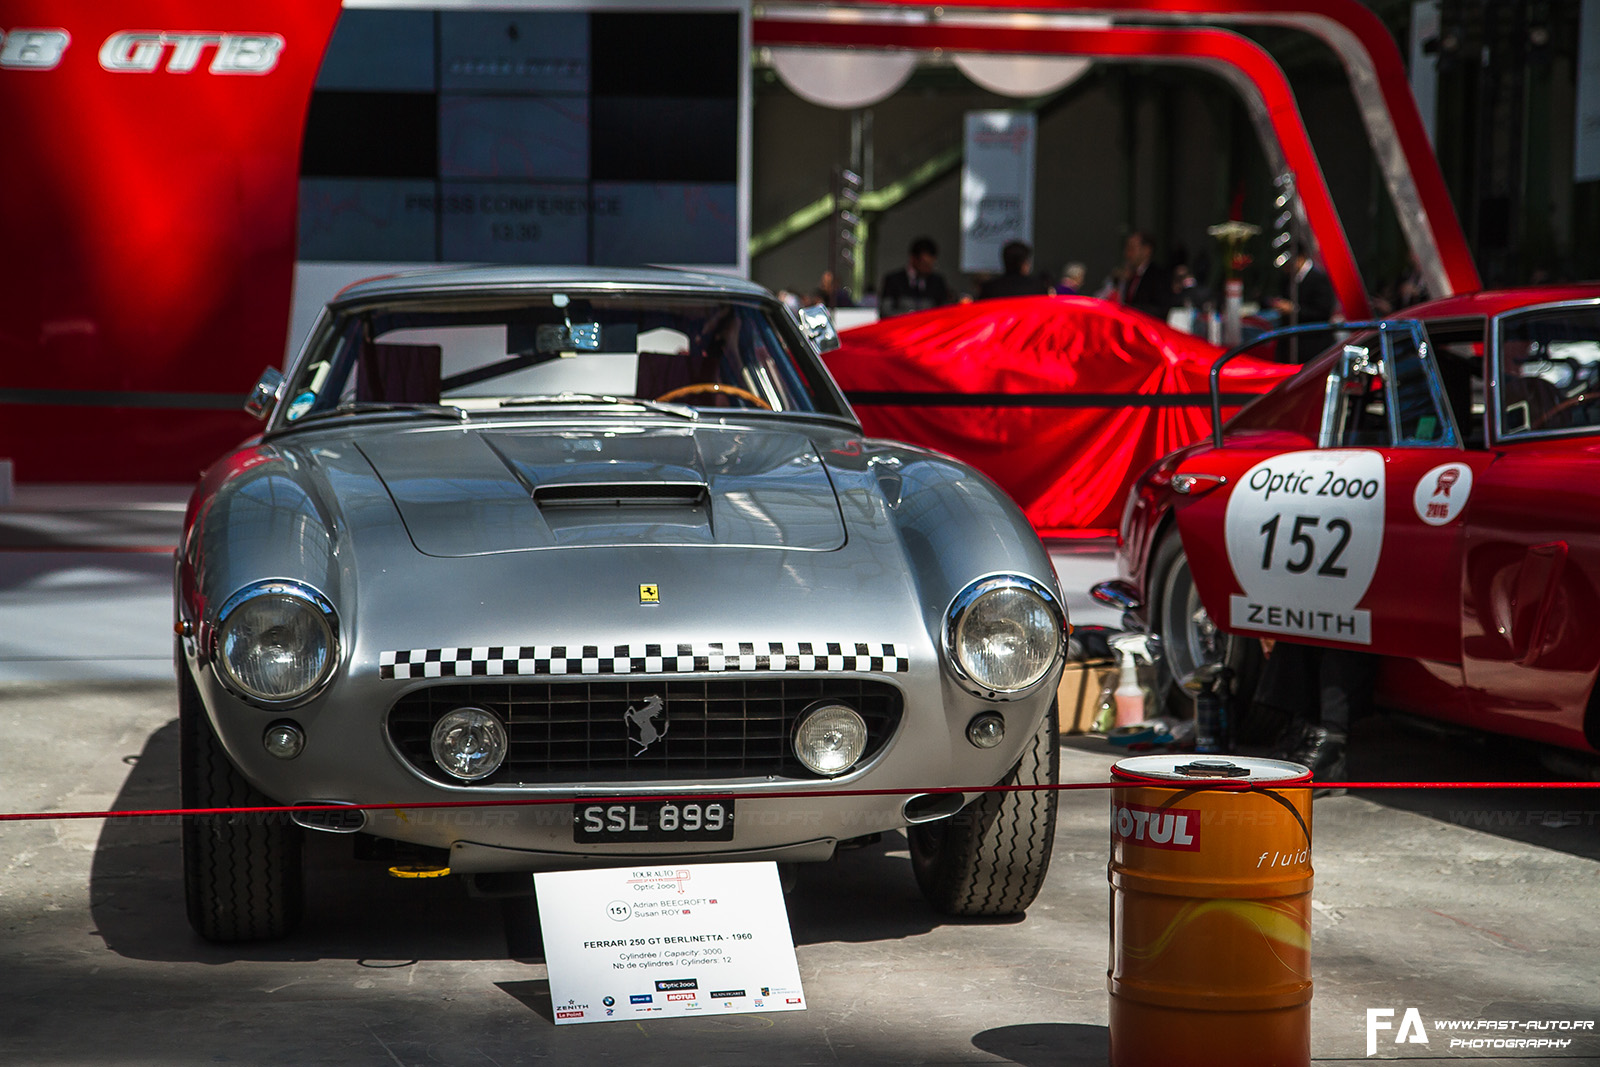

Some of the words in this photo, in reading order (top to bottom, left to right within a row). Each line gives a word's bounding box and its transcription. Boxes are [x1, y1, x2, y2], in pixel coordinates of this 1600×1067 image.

[98, 29, 285, 75] GTB
[1250, 467, 1314, 501] Optic
[1317, 471, 1379, 500] 2000
[1259, 512, 1353, 578] 152
[1247, 604, 1356, 635] ZENITH
[584, 806, 648, 833] SSL
[659, 804, 725, 831] 899
[660, 898, 707, 907] BEECROFT
[610, 907, 627, 915] 151
[584, 939, 627, 949] FERRARI
[630, 938, 645, 946] 250
[648, 937, 661, 945] GT
[664, 934, 724, 944] BERLINETTA
[732, 933, 753, 941] 1960
[619, 951, 657, 961] Cylindrée
[613, 962, 625, 970] Nb
[627, 961, 637, 969] de
[638, 960, 674, 969] cylindres
[668, 993, 694, 1001] MOTUL
